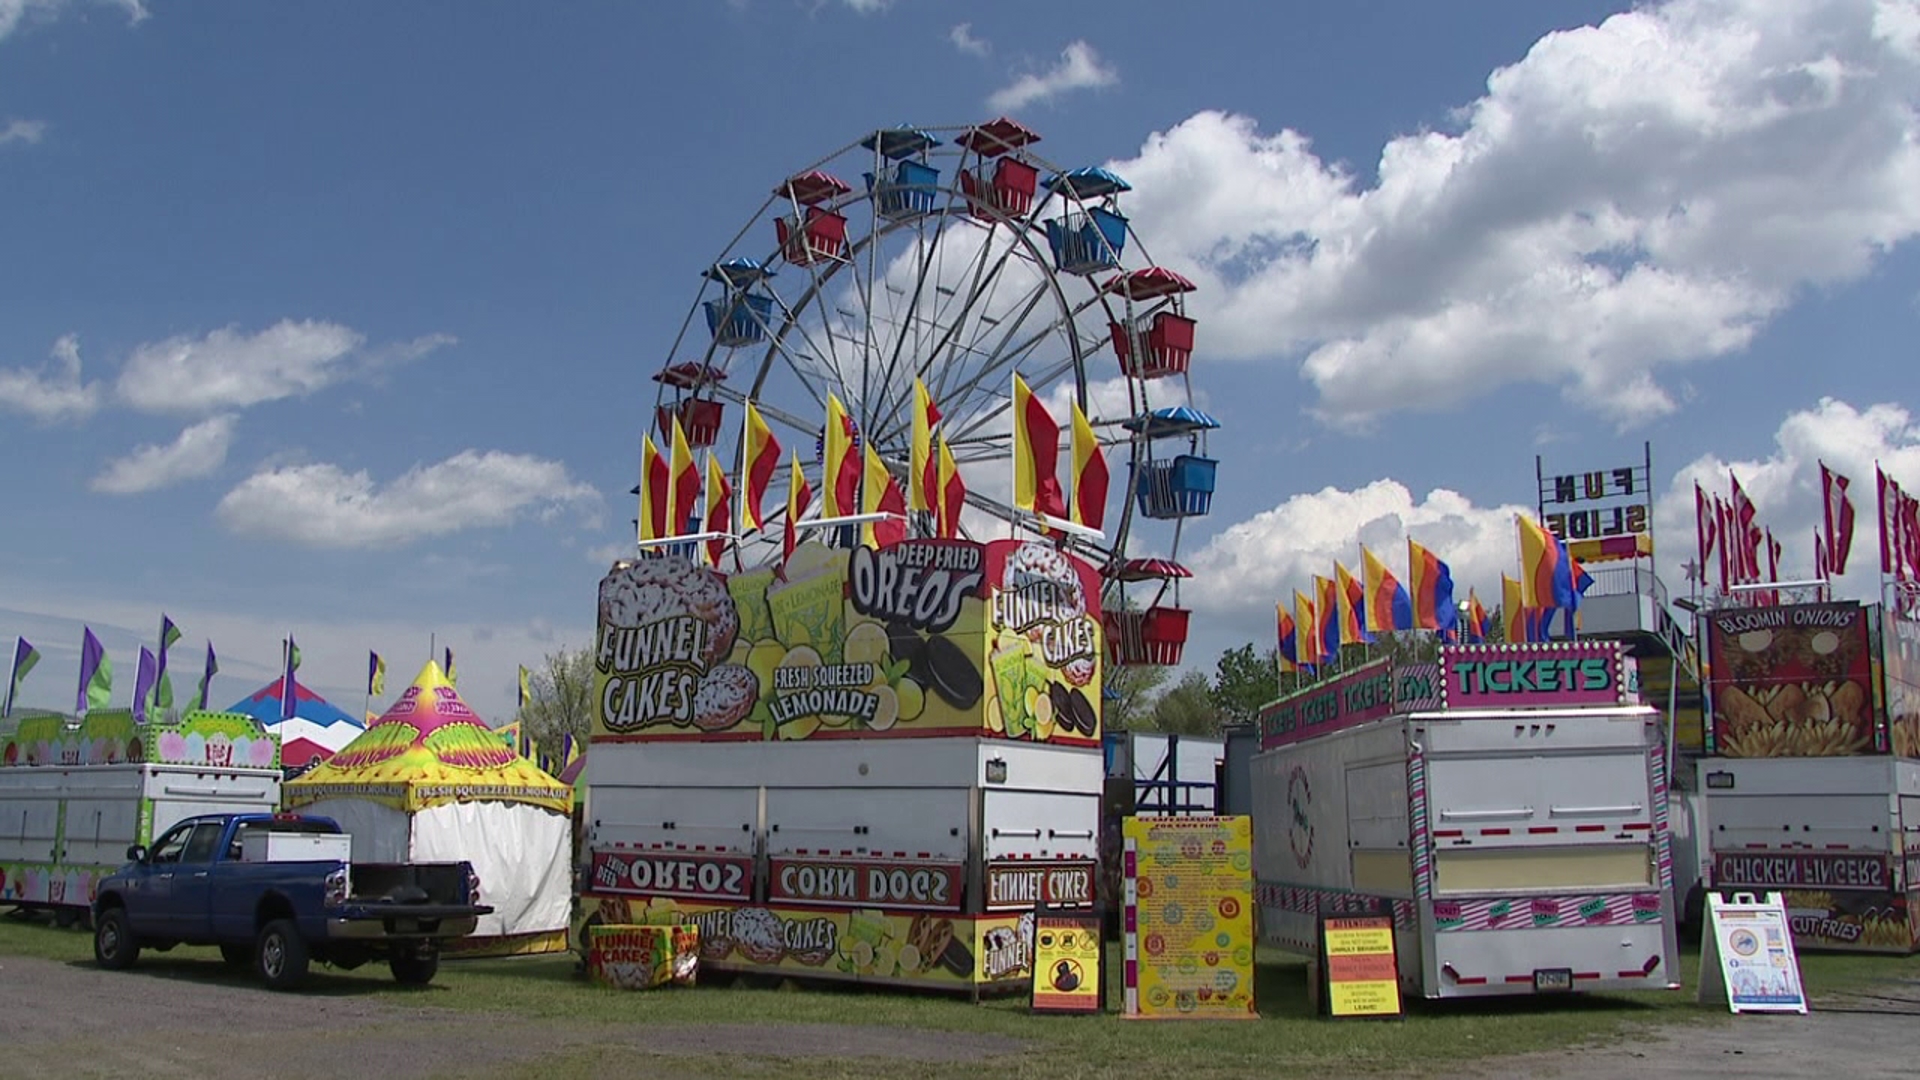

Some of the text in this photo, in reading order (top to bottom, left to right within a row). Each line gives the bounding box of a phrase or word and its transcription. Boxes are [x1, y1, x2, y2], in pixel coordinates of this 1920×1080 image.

[896, 543, 980, 570] DEEP FRIED
[854, 547, 983, 626] OREOS
[991, 580, 1060, 630] FUNNEL
[1717, 610, 1786, 634] BLOOMIN
[1793, 609, 1856, 627] ONIONS
[598, 616, 706, 673] FUNNEL
[1043, 617, 1094, 663] CAKES
[774, 663, 873, 688] FRESH SQUEEZED
[1451, 657, 1611, 694] TICKETS
[603, 670, 693, 726] CAKES
[768, 689, 878, 723] LEMONADE
[1301, 690, 1338, 728] TICKETS
[1343, 671, 1390, 714] TICKETS
[416, 784, 569, 798] FRESH SQUEEZED LEMONADE
[594, 933, 655, 949] FUNNEL
[784, 918, 836, 950] CAKES
[1791, 917, 1862, 940] CUT FRIES
[602, 949, 650, 964] CAKES
[984, 942, 1029, 975] FUNNEL
